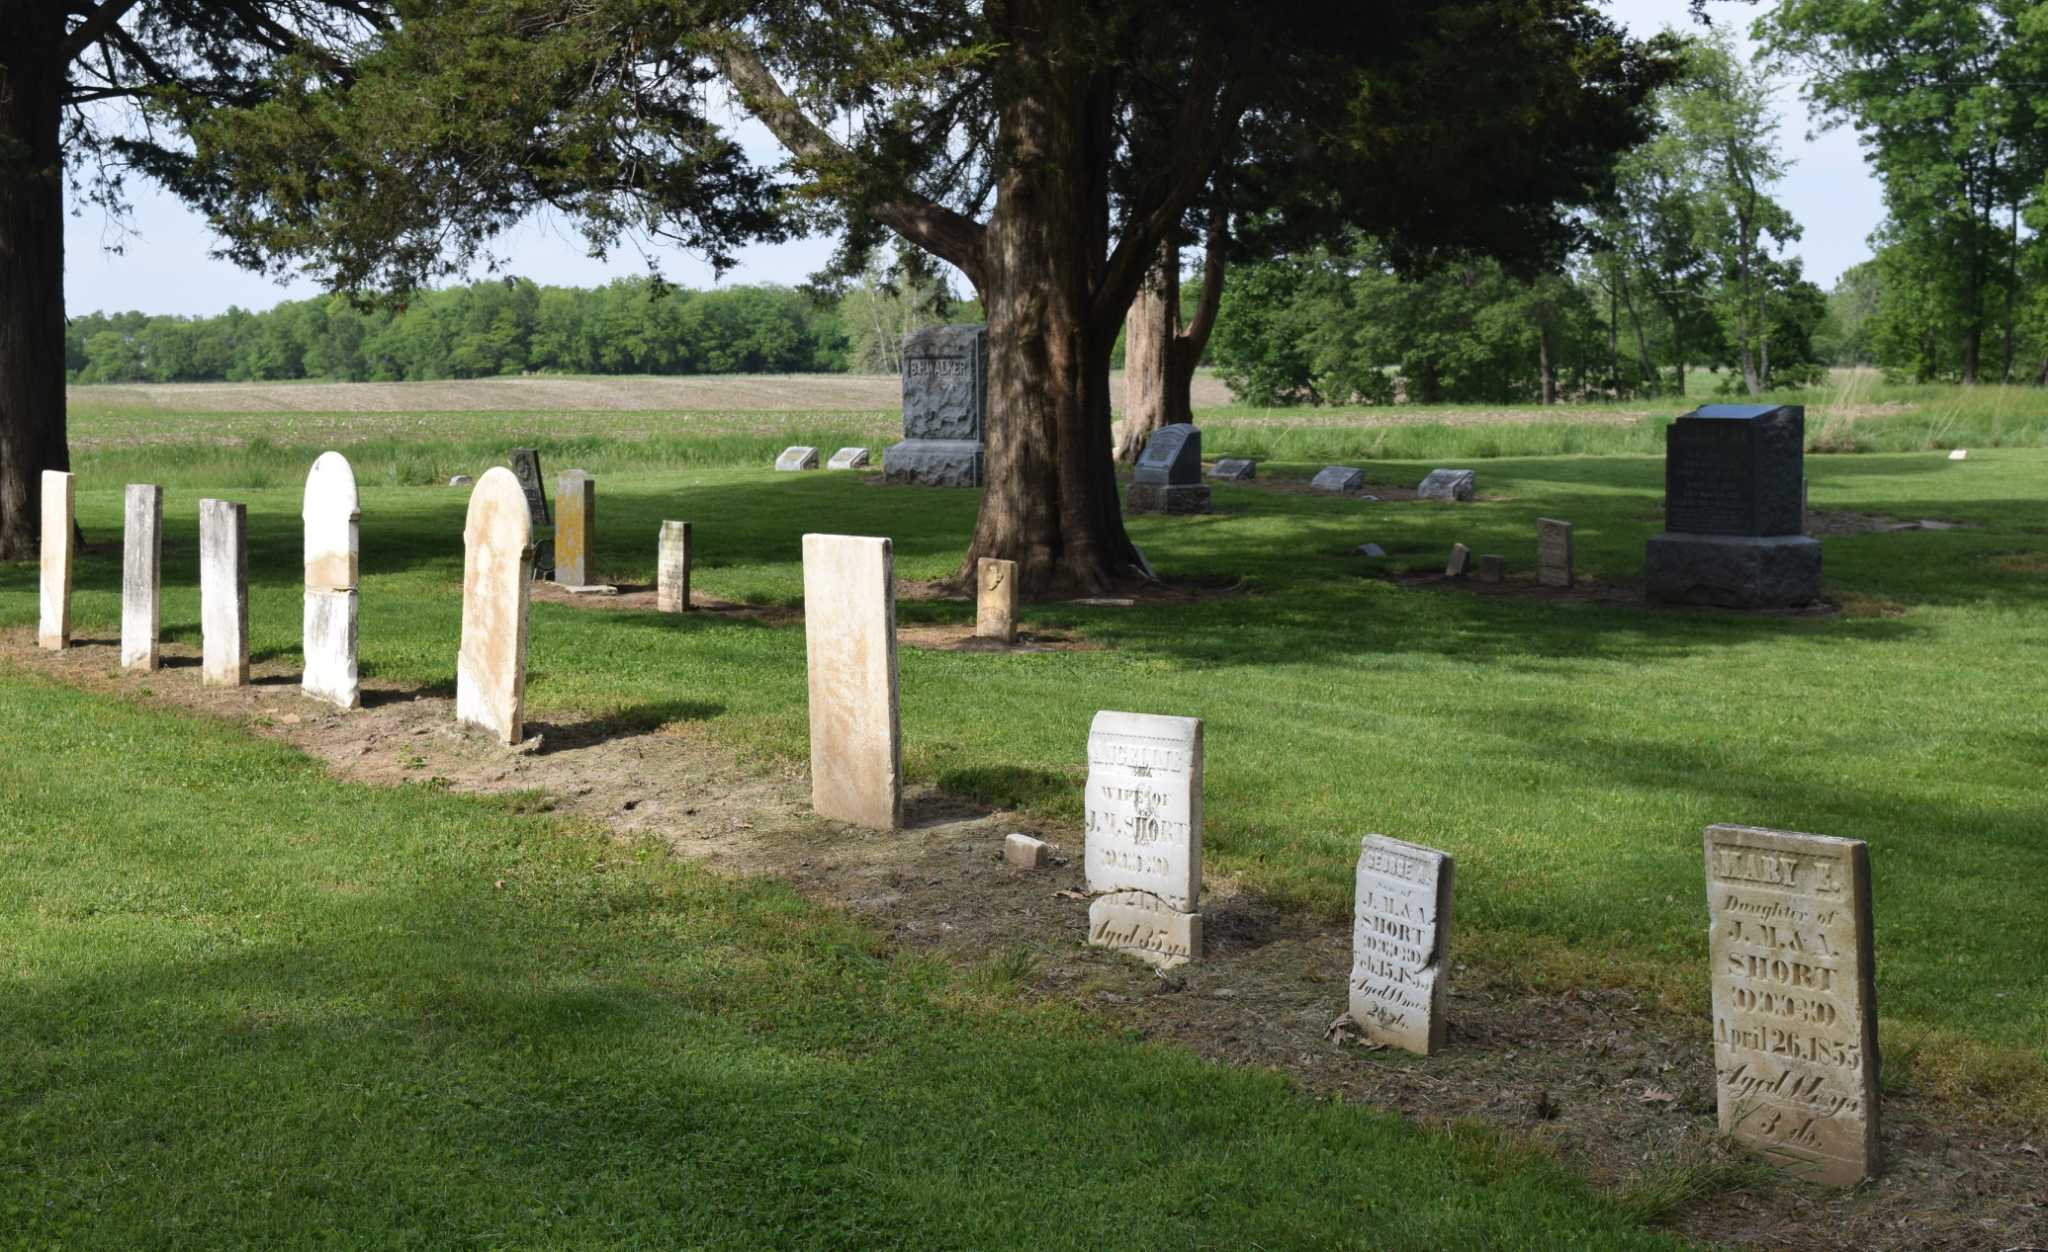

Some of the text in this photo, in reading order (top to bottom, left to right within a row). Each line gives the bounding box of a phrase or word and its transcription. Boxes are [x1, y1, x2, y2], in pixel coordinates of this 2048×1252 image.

[1712, 850, 1799, 888] MARY
[1723, 894, 1809, 922] Daughter
[1361, 915, 1426, 949] SHORT
[1727, 951, 1839, 993] SHORT
[1731, 985, 1837, 1028] DIED
[1715, 1018, 1767, 1054] April
